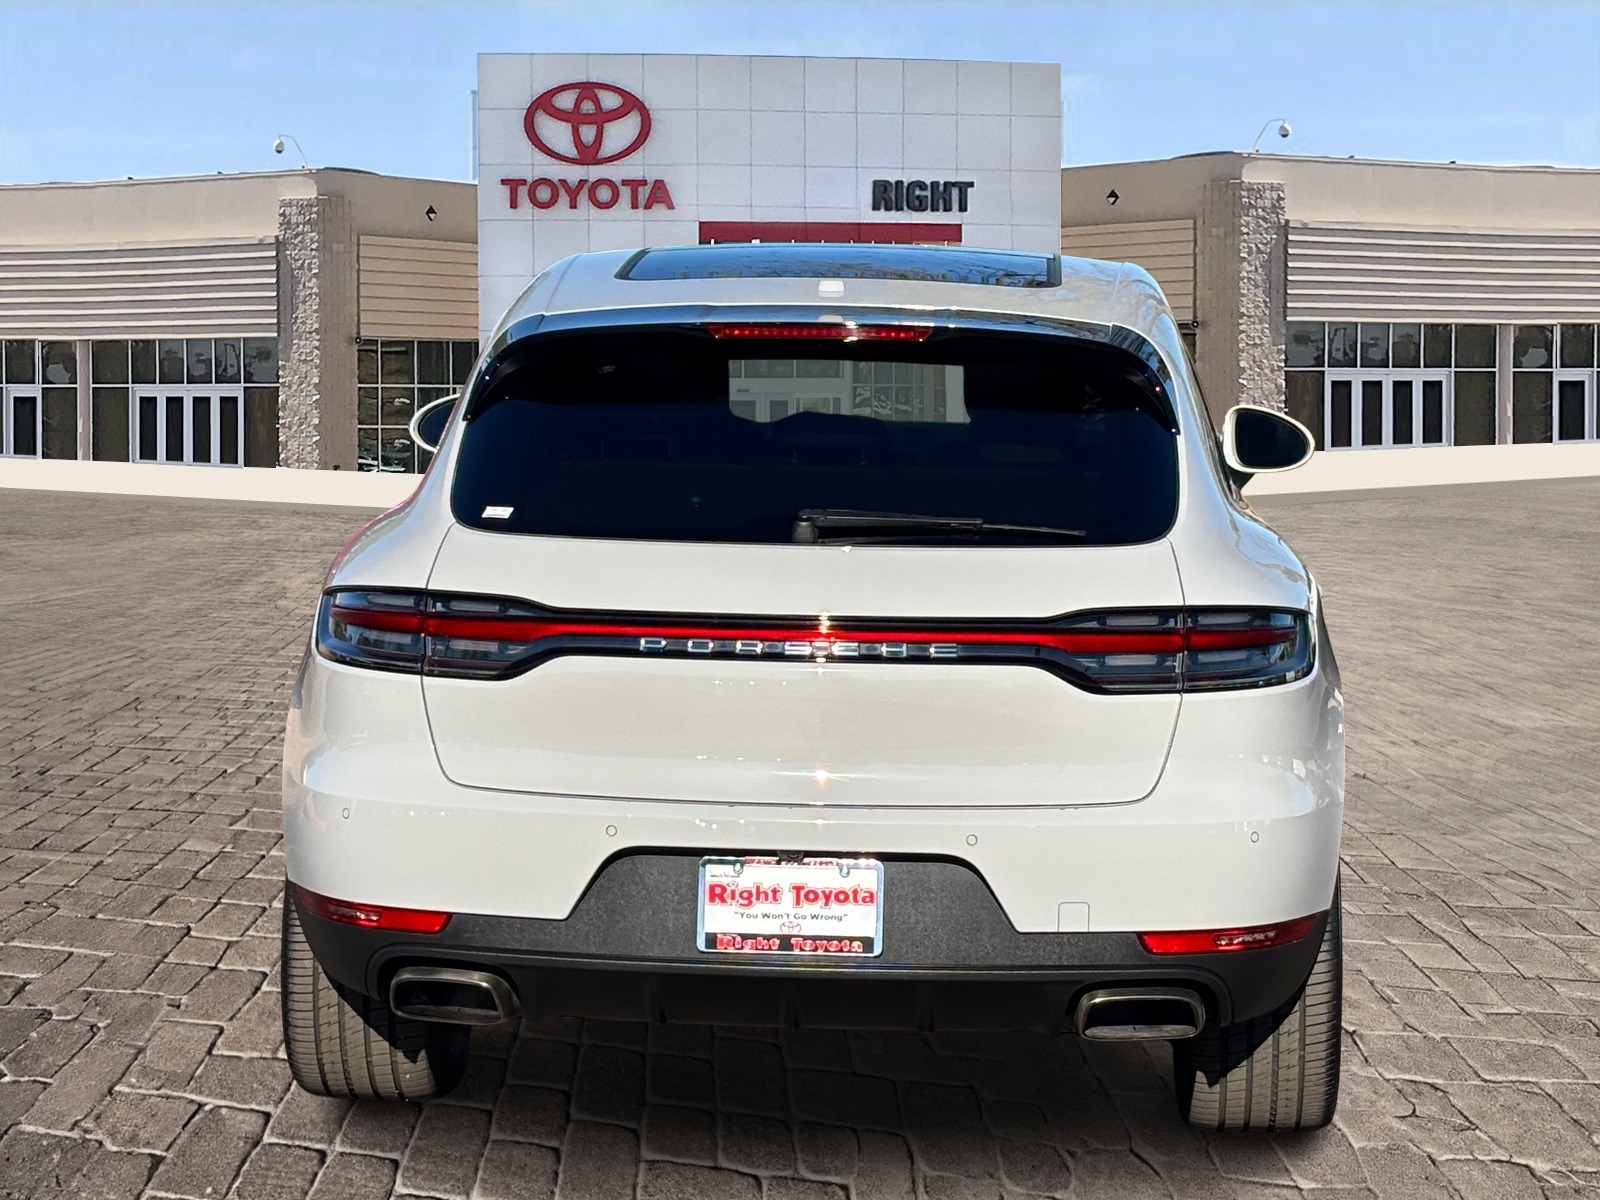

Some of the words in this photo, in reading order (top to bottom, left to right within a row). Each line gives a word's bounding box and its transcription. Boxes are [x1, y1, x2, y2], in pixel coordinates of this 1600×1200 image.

[500, 178, 675, 210] TOYOTA
[871, 179, 975, 213] RIGHT
[639, 637, 958, 658] PORSCHE
[707, 882, 783, 909] Right
[790, 883, 877, 909] Toyota
[734, 911, 758, 919] "You
[761, 912, 790, 920] Won't
[793, 912, 807, 920] Go
[810, 913, 848, 922] Wrong"
[716, 934, 780, 951] Right
[790, 937, 864, 952] Toyota
